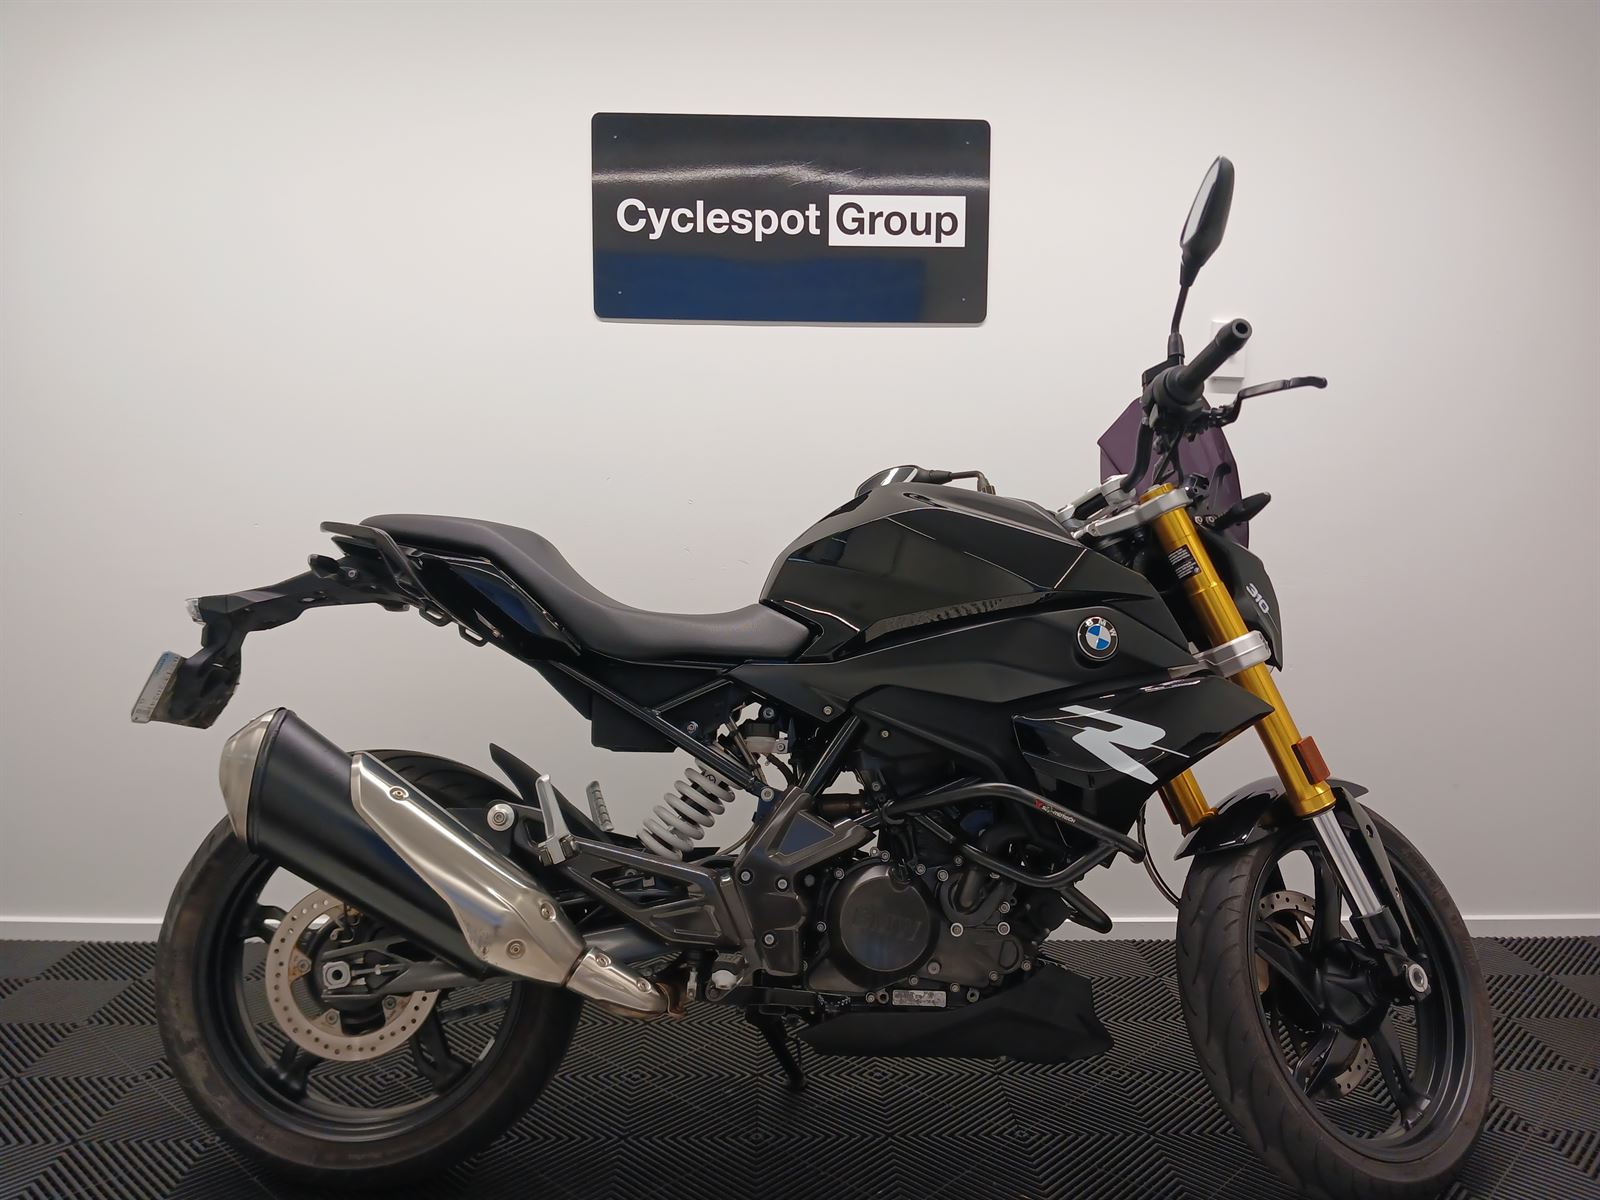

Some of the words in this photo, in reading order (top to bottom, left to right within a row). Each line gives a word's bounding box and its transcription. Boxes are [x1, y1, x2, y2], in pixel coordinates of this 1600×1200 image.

[616, 198, 821, 242] Cyclespot
[836, 202, 959, 243] Group
[1246, 583, 1270, 614] 310
[1085, 616, 1117, 637] BMW
